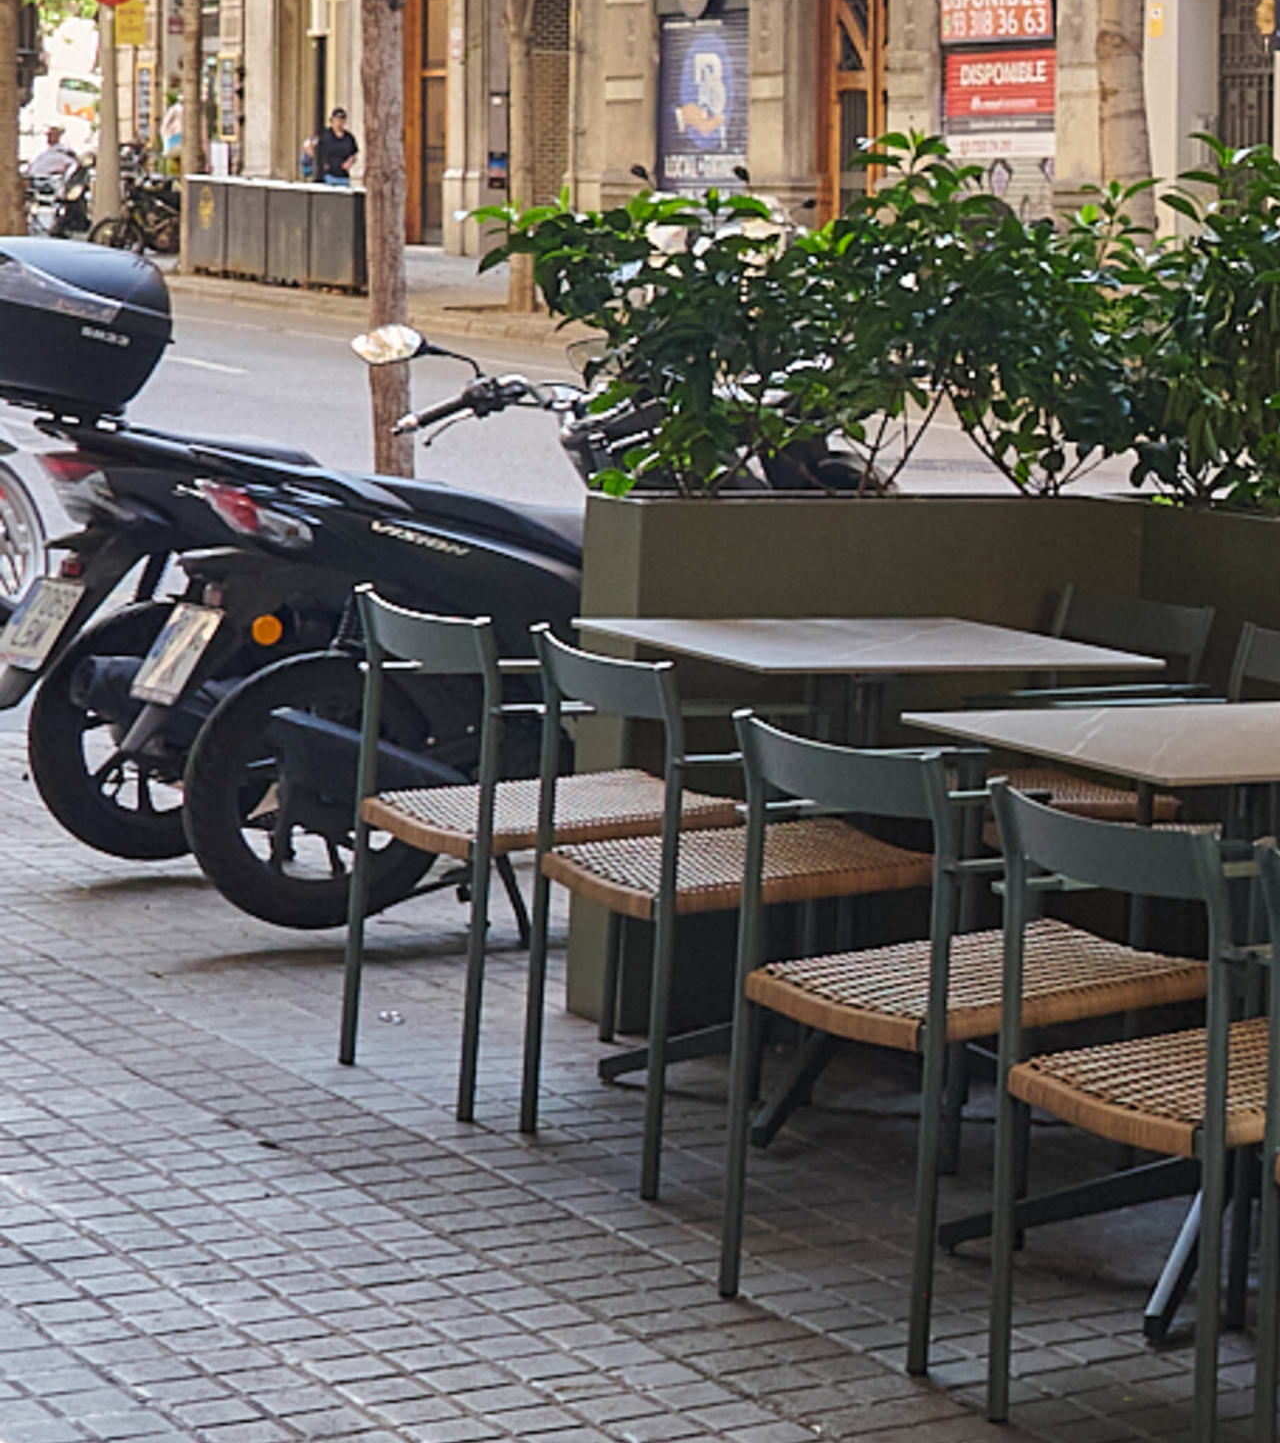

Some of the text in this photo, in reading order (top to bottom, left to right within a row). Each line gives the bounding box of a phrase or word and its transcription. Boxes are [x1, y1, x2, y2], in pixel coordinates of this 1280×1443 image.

[997, 7, 1019, 35] 36
[1023, 6, 1046, 34] 63
[960, 59, 1047, 86] DISPONIBLE
